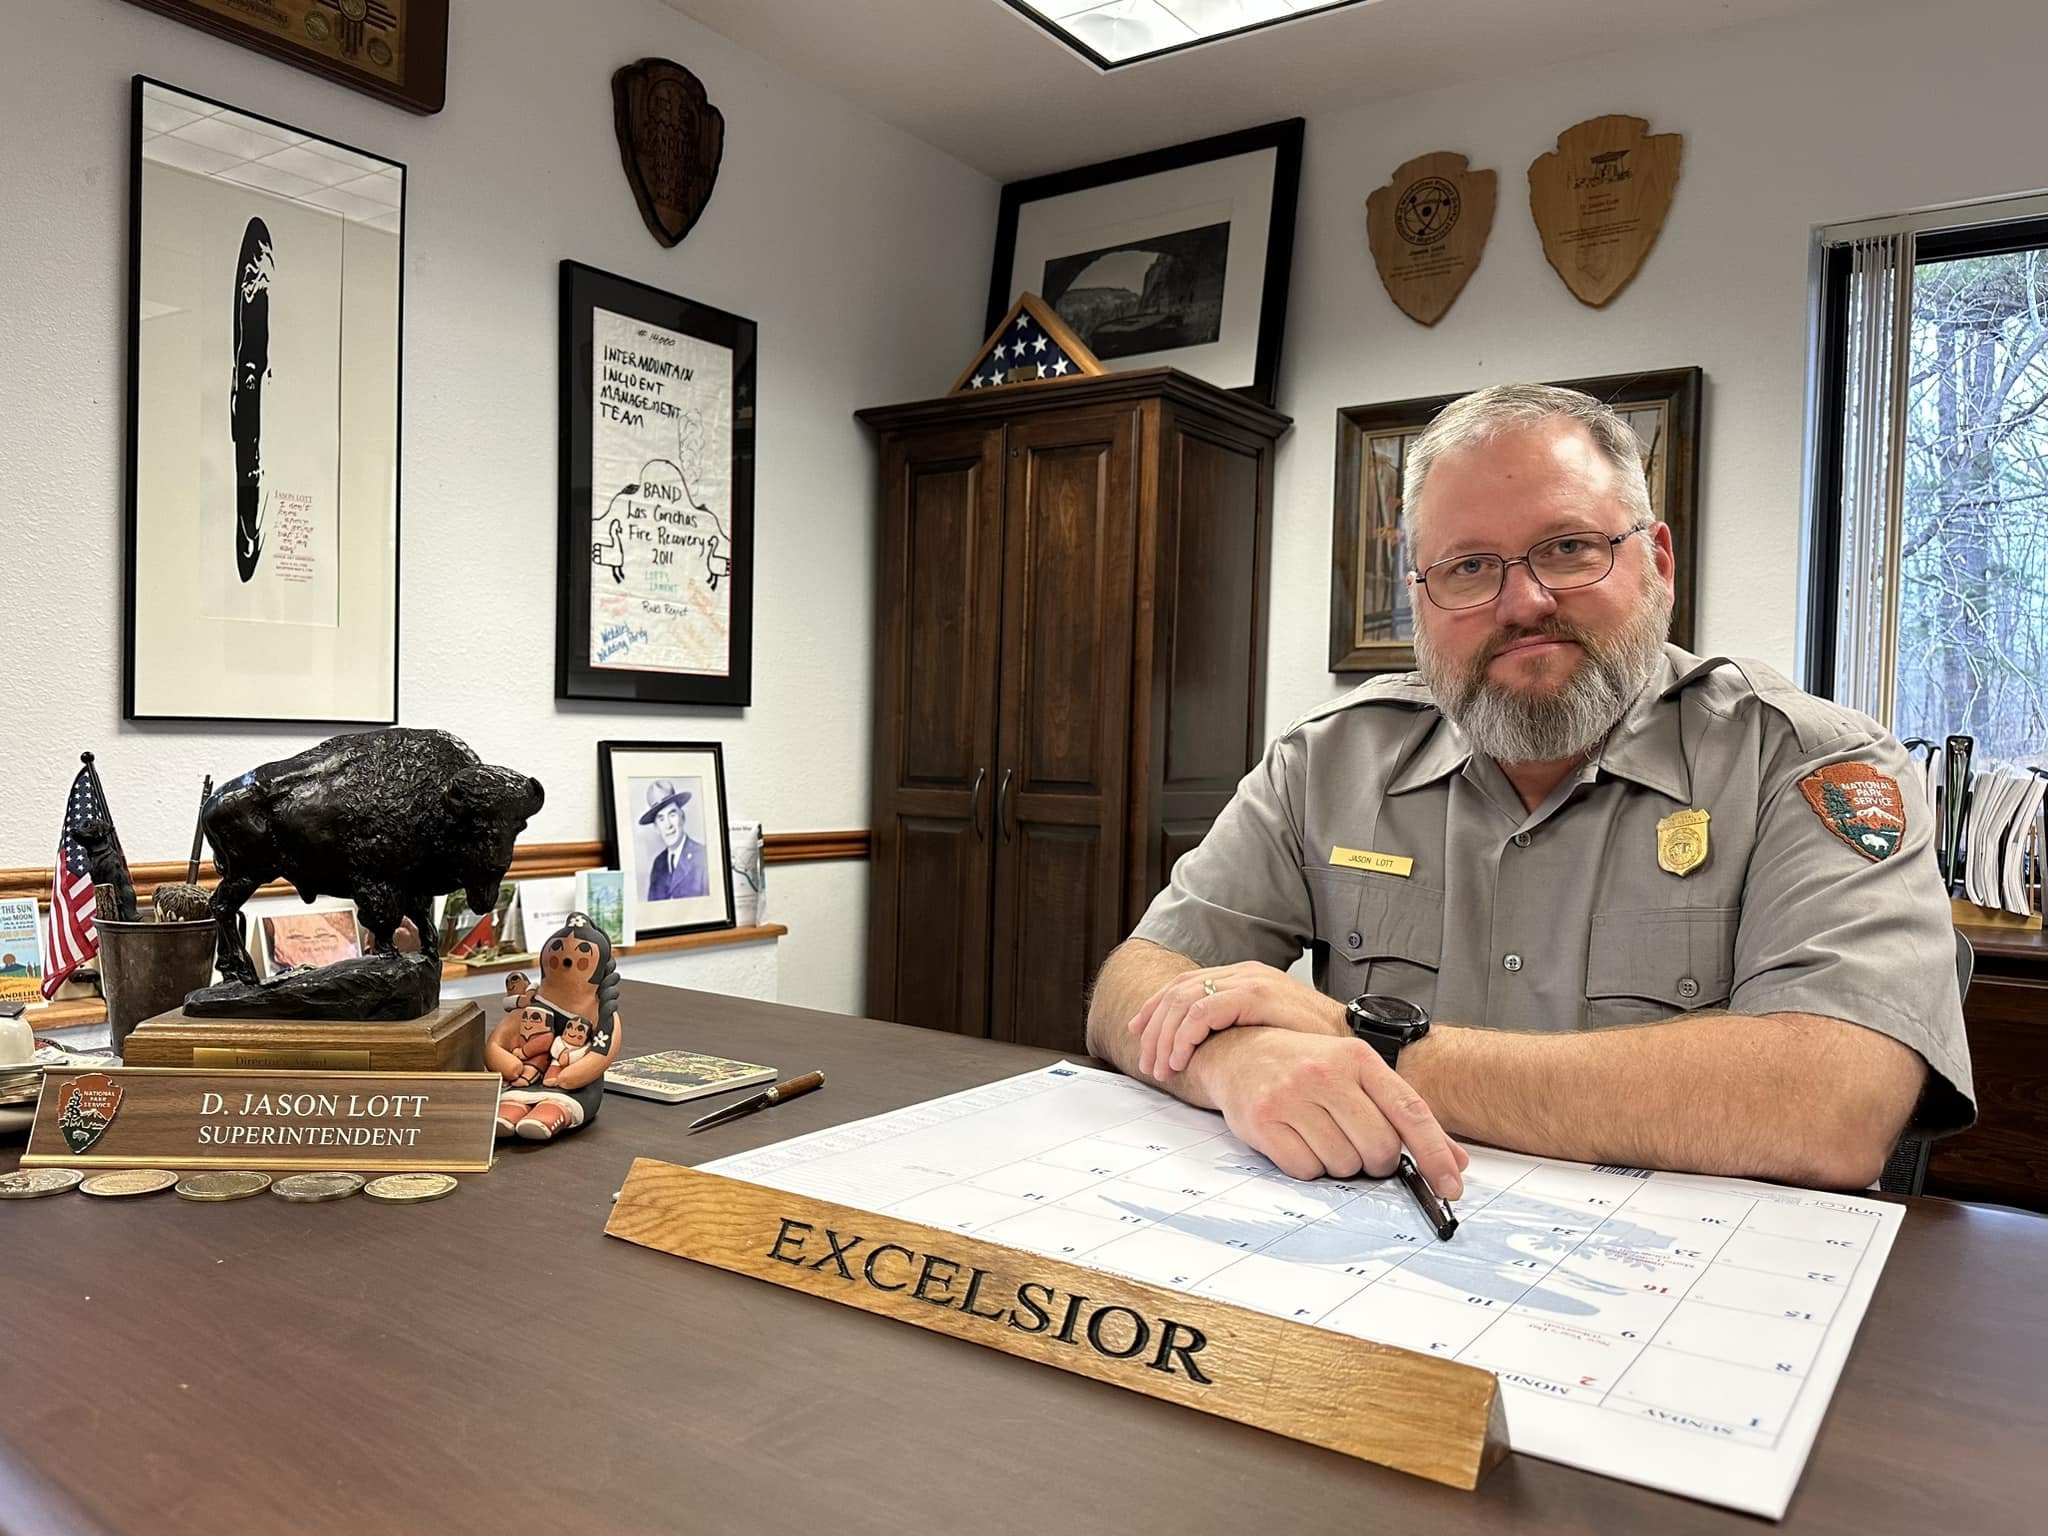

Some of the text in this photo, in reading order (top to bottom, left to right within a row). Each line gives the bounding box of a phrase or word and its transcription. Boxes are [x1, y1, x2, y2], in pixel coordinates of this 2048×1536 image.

[603, 344, 694, 381] INTERMOUNTAIN
[603, 365, 664, 395] INCIDENT
[600, 384, 682, 419] MANAGEMENT
[599, 401, 644, 428] TEAM
[644, 481, 682, 504] BAND
[628, 523, 705, 558] Fire Recovery
[652, 547, 673, 565] 2011
[1840, 780, 1894, 790] NATIONAL
[1856, 789, 1883, 798] PARK
[1854, 796, 1895, 807] SERVICE
[1348, 854, 1394, 868] JASON LOTT
[1, 903, 33, 914] THE SUN
[0, 990, 41, 999] ANDELIER
[200, 1093, 430, 1118] D. JASON LOTT
[198, 1125, 421, 1147] SUPERINTENDENT
[1023, 1192, 1045, 1200] 14
[1119, 1215, 1143, 1223] 13
[1282, 1211, 1306, 1219] 19
[1701, 1217, 1729, 1225] 30
[1552, 1226, 1579, 1236] 24
[1225, 1239, 1249, 1247] 12
[1392, 1233, 1417, 1242] 18
[1825, 1238, 1853, 1247] 29
[1674, 1248, 1702, 1258] 23
[1512, 1259, 1538, 1268] 17
[1344, 1266, 1366, 1276] 11
[1807, 1271, 1837, 1282] 22
[1642, 1283, 1669, 1294] 16
[766, 1217, 1213, 1386] EXCELSIOR
[1468, 1296, 1494, 1306] 10
[1784, 1310, 1812, 1321] 15
[1775, 1362, 1792, 1372] 8
[1494, 1370, 1570, 1395] MONDA
[1579, 1375, 1598, 1387] 2
[1642, 1408, 1733, 1435] SUNDAY
[1748, 1417, 1759, 1428] 1
